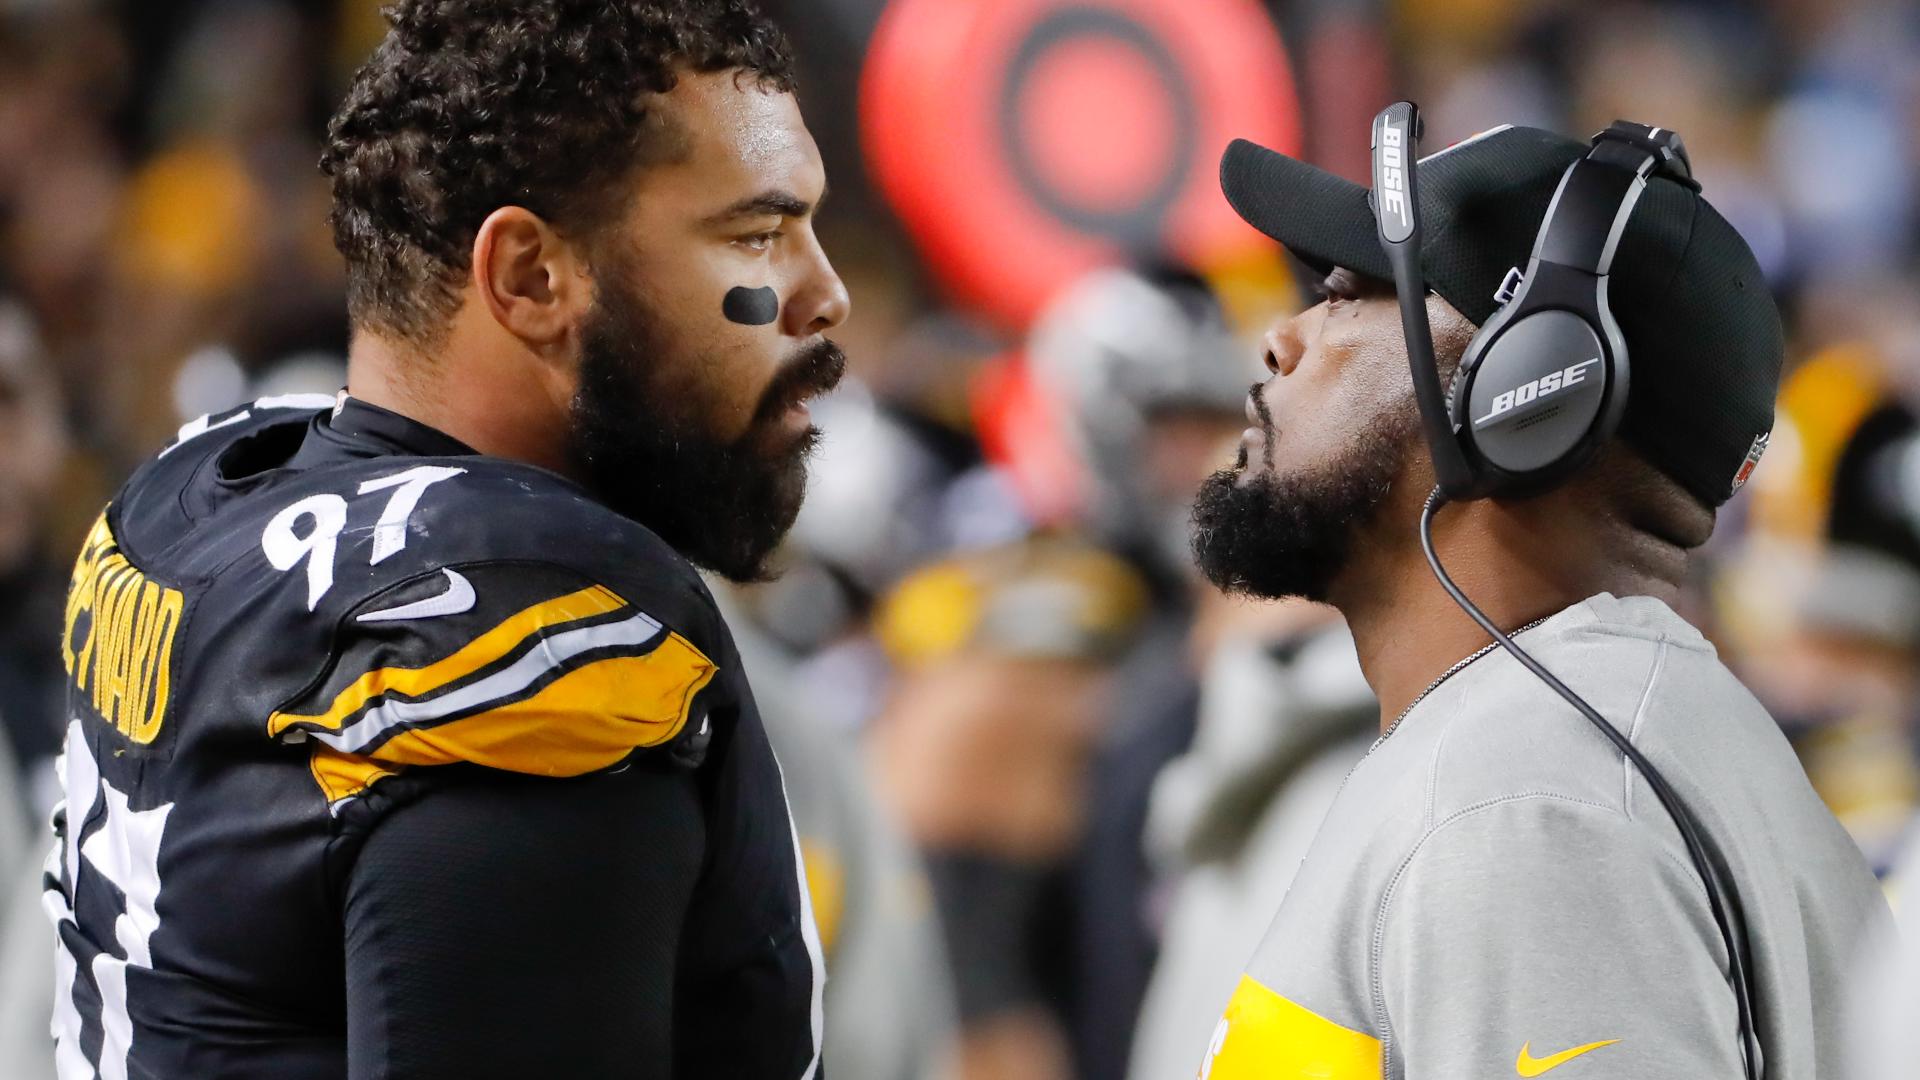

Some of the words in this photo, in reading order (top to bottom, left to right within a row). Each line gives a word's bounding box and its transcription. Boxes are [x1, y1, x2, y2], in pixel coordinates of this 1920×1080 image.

[1383, 114, 1407, 228] BOSE
[1475, 357, 1599, 425] BOSE
[261, 465, 469, 613] 97
